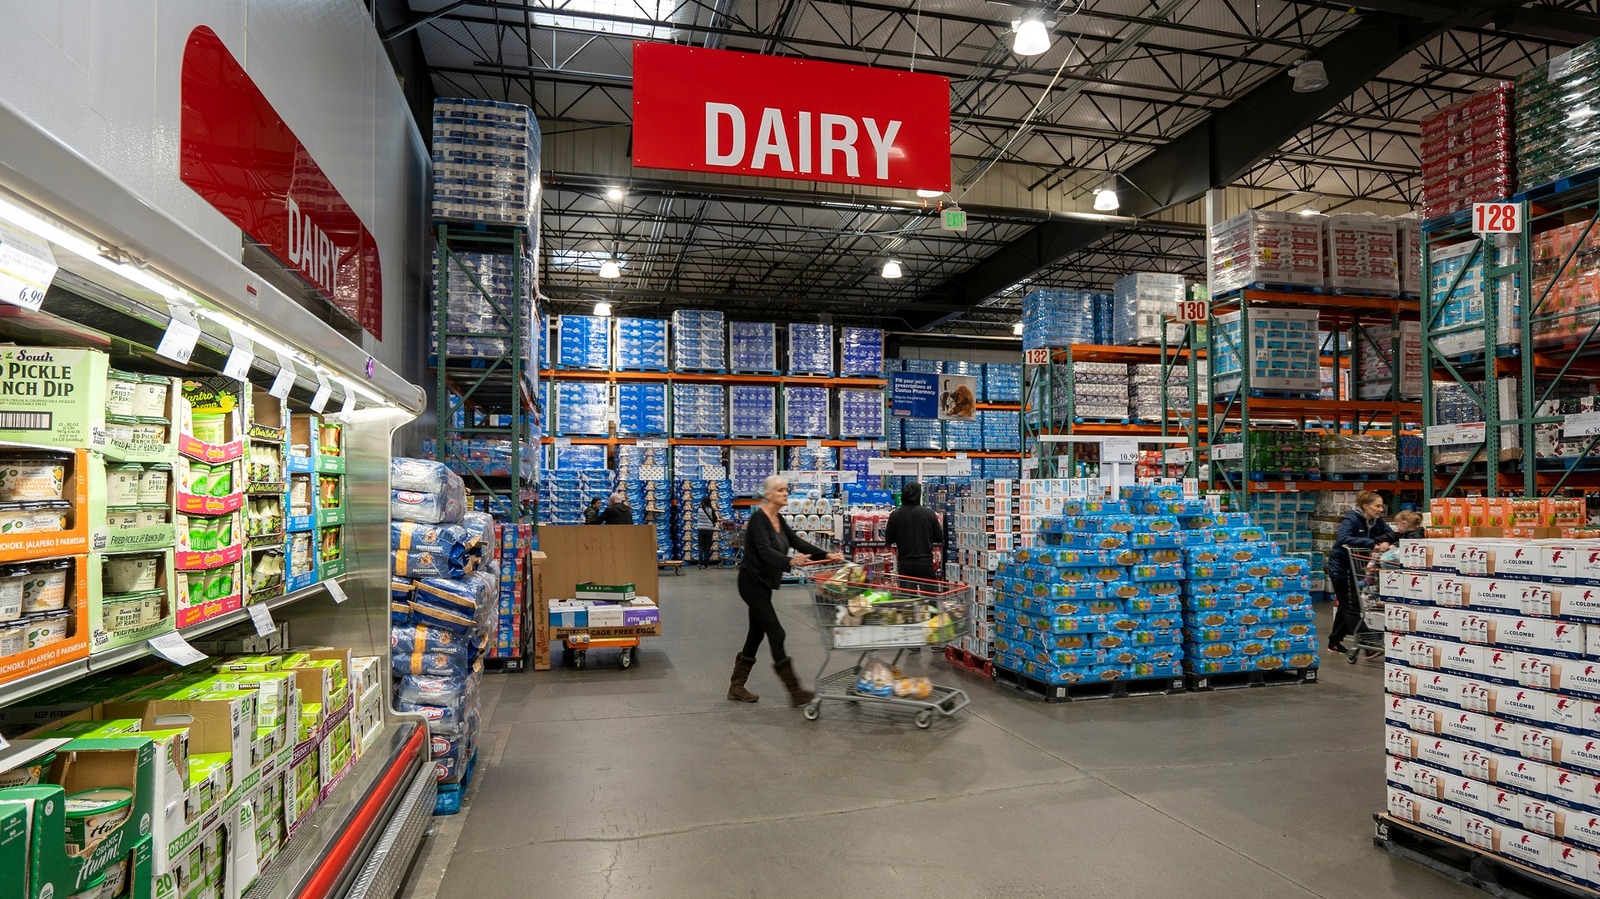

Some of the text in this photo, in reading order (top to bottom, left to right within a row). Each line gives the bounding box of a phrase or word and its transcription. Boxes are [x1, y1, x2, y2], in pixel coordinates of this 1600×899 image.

[705, 101, 902, 179] DAIRY
[946, 211, 964, 227] EXIT
[1475, 205, 1516, 231] 128
[288, 197, 340, 297] DAIRY
[19, 286, 44, 305] 6.99
[1178, 302, 1206, 320] 130
[17, 349, 53, 361] South
[176, 348, 191, 360] 6.89
[1027, 350, 1048, 364] 132
[8, 362, 71, 380] PICKLE
[0, 380, 75, 398] NCH DIP
[1120, 453, 1138, 461] 10.99
[60, 537, 85, 545] PARMESAN
[636, 627, 656, 635] EGGS
[60, 641, 87, 654] PARMESAN
[1452, 656, 1475, 664] COLOMBE
[1427, 684, 1449, 692] COLOMBE
[241, 698, 250, 714] 20
[1509, 701, 1535, 710] COLOMBE
[34, 711, 48, 719] KEEP
[1453, 723, 1476, 732] COLOMBE
[1510, 771, 1536, 782] COLOMBE
[1456, 790, 1479, 800] COLOMBE
[240, 805, 251, 820] 20
[1580, 827, 1600, 836] COLOM
[96, 833, 119, 857] ORGANIC
[169, 823, 199, 857] ORGANIC
[1514, 842, 1540, 855] COLOMBE
[156, 873, 173, 897] 20
